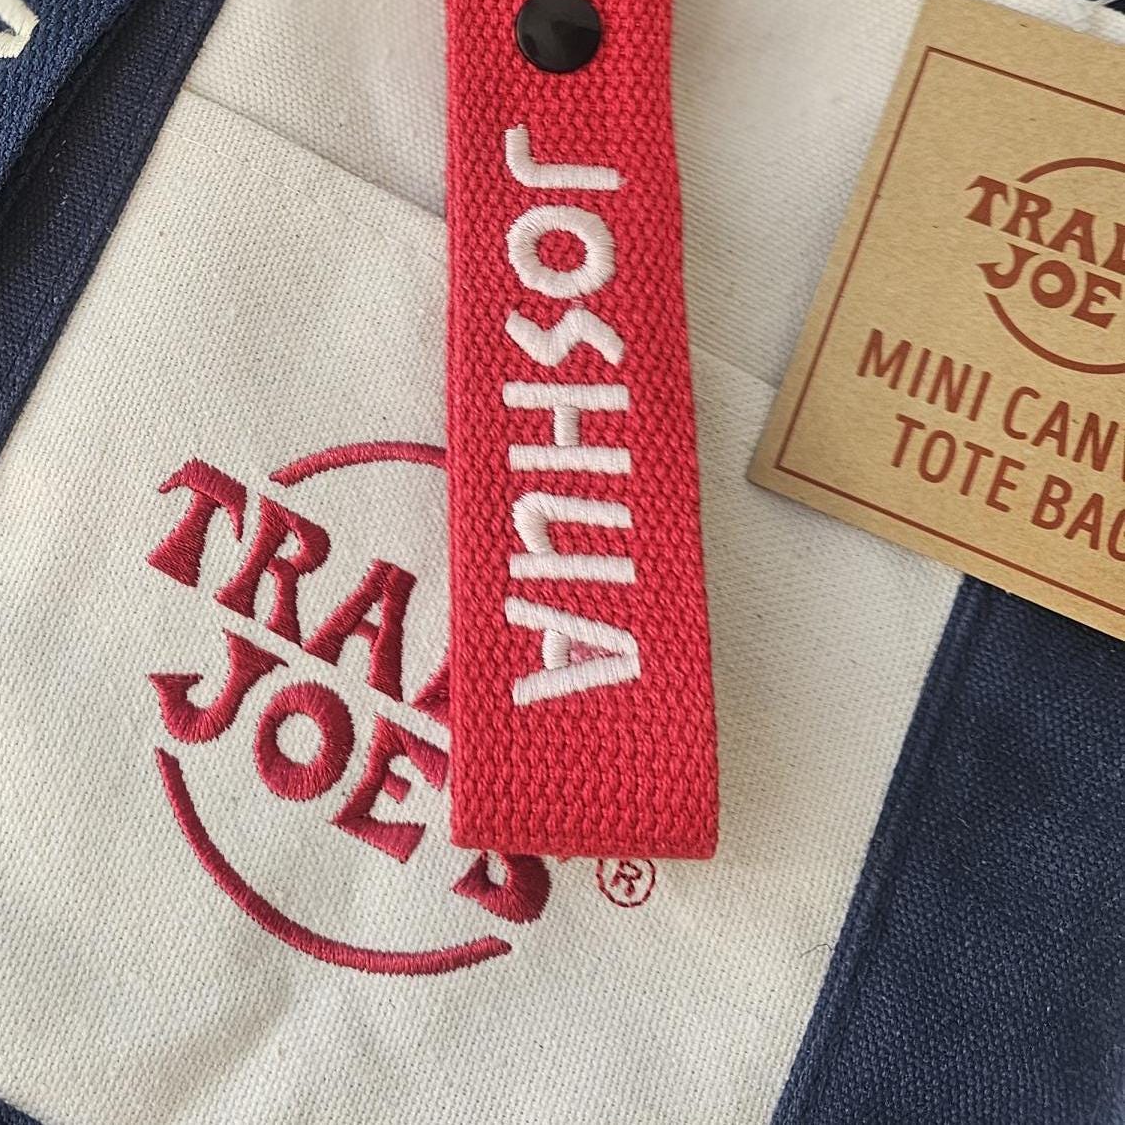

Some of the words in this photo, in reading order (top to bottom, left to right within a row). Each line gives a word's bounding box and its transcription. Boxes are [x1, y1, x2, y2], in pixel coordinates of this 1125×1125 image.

[965, 175, 1125, 275] TRA
[502, 123, 641, 706] JOSHUA
[856, 328, 991, 421] MINI
[1003, 386, 1125, 482] CAN
[890, 413, 1026, 513] TOTE
[146, 457, 449, 724] TRA
